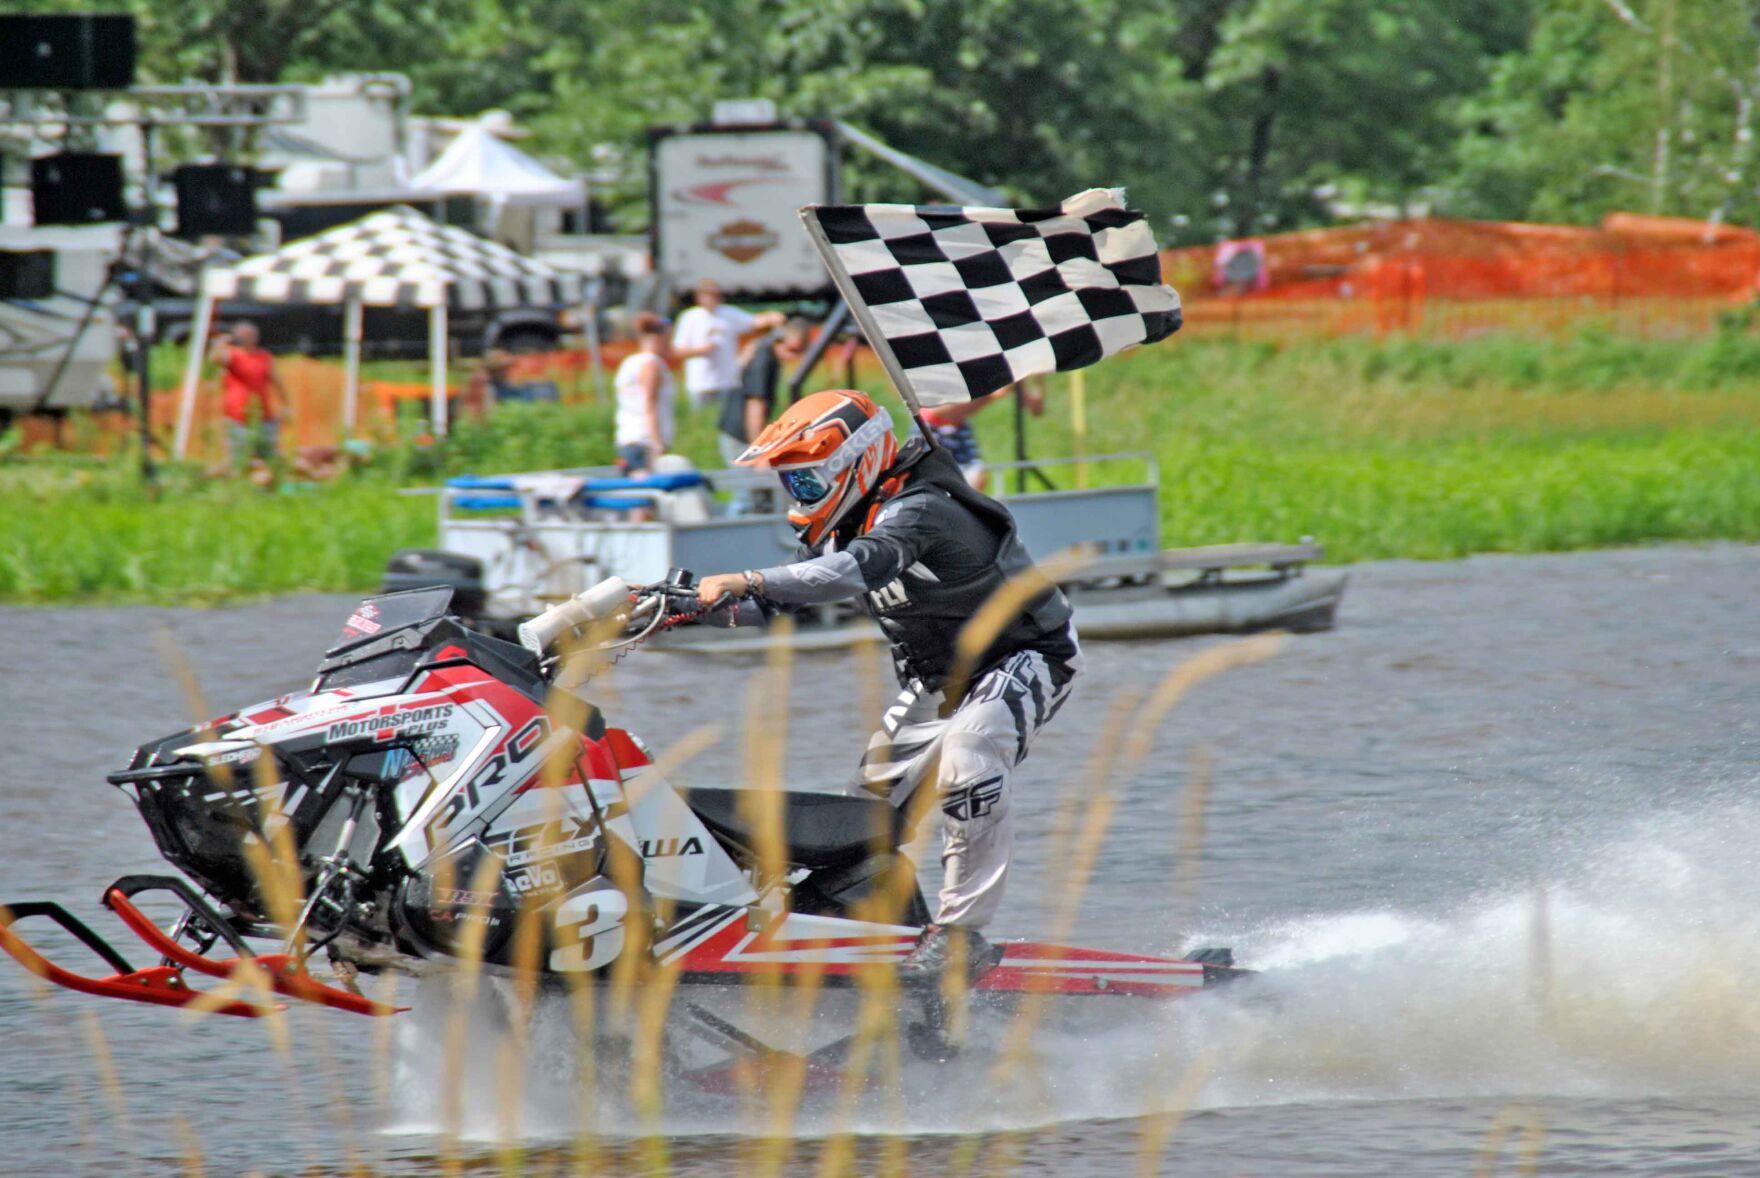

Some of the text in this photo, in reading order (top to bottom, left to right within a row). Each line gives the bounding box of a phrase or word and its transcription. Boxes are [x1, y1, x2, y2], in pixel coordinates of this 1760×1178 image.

[869, 577, 911, 605] FLY
[406, 718, 449, 736] PLUS
[423, 716, 550, 854] PRO
[548, 888, 629, 973] 3
